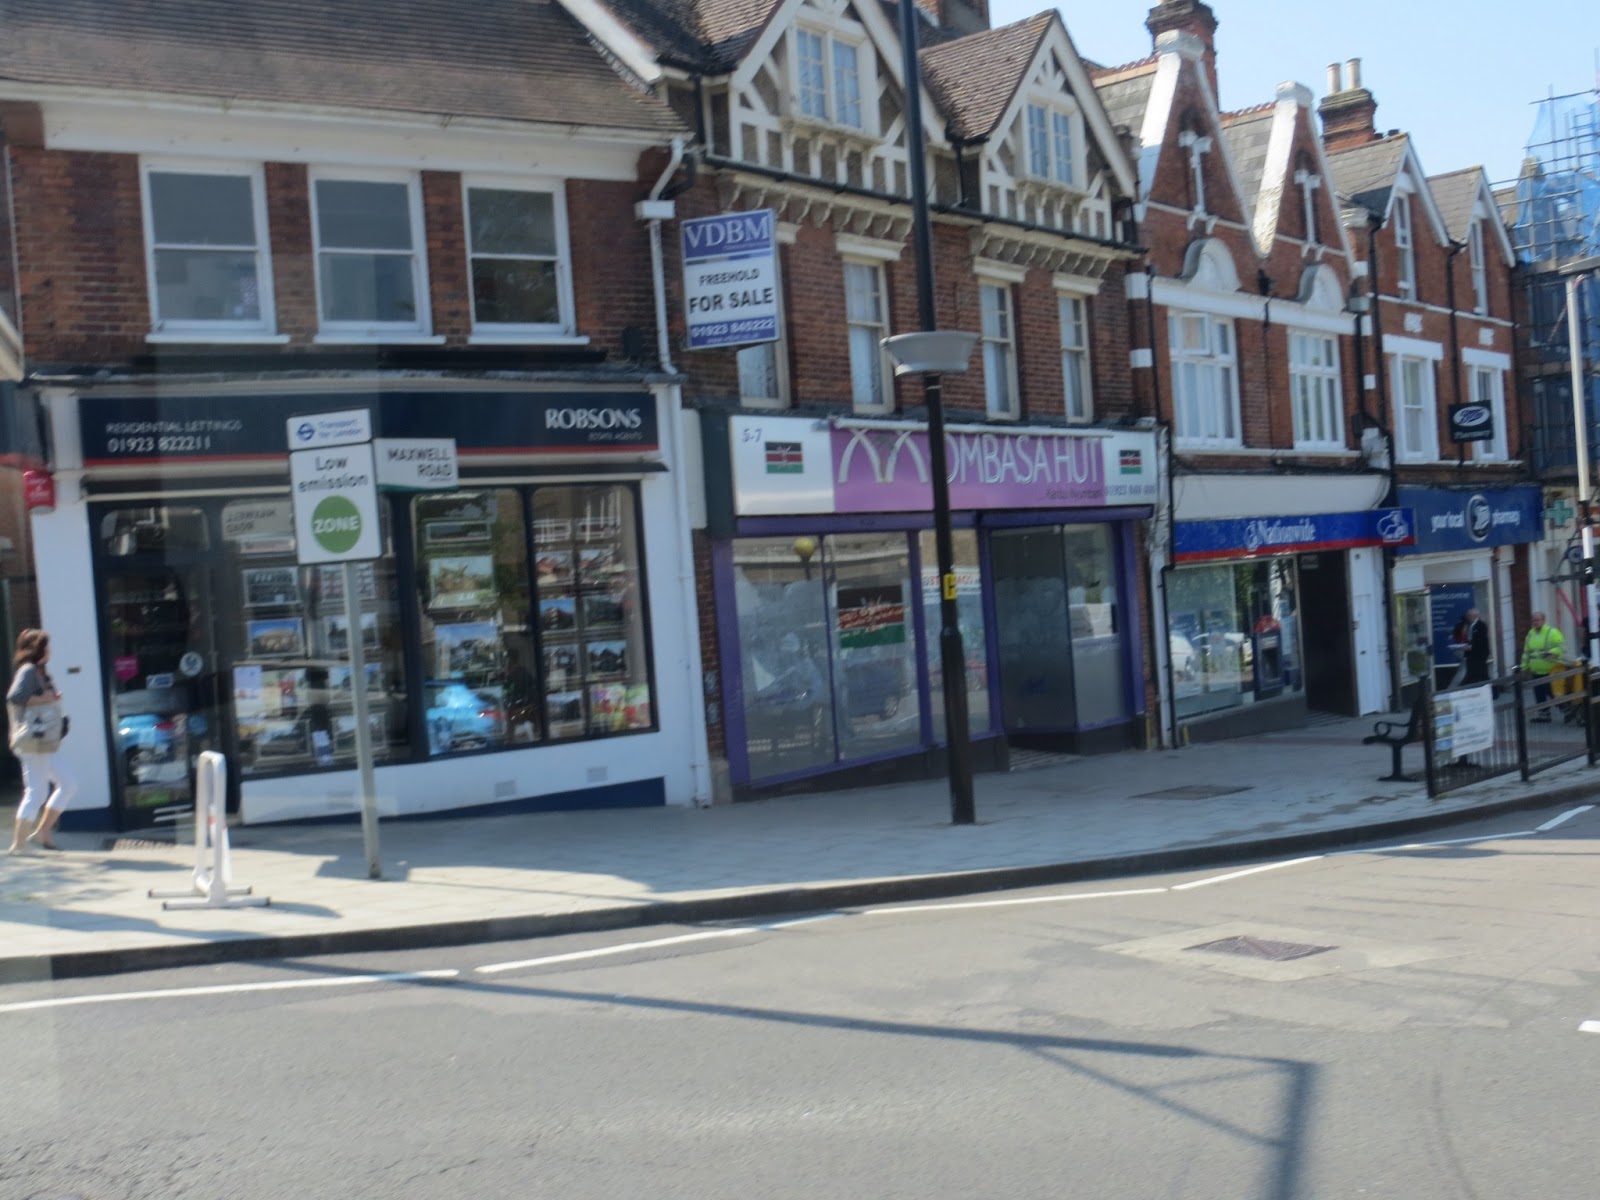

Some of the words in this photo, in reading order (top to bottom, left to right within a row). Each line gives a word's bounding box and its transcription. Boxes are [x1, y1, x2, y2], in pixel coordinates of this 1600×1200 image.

[685, 215, 769, 249] VDBM
[699, 268, 761, 286] FREEHOLD
[689, 295, 723, 314] FOR
[729, 287, 774, 309] SALE
[106, 420, 184, 434] RESIDENTIAL
[184, 419, 243, 433] LETTINGS
[545, 408, 642, 429] ROBSONS
[107, 436, 155, 453] 01923
[158, 435, 211, 451] 822211
[315, 456, 348, 471] Low
[387, 447, 450, 461] MAXWELL
[1053, 436, 1100, 484] HUT
[417, 463, 453, 477] ROAD
[298, 473, 369, 492] emission
[313, 515, 360, 535] ZONE
[1257, 517, 1316, 545] Nationwide
